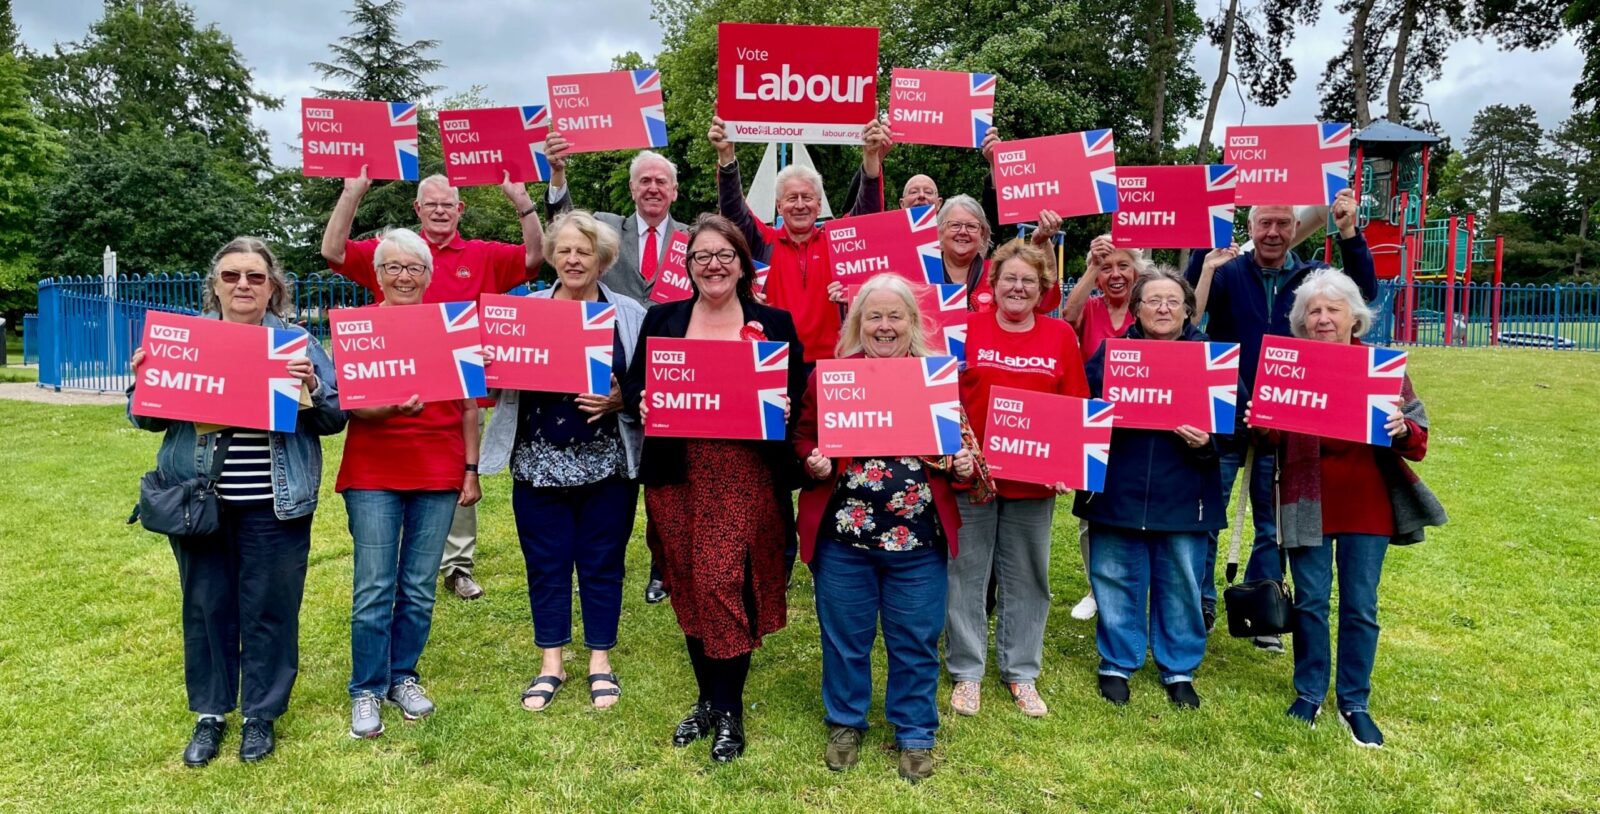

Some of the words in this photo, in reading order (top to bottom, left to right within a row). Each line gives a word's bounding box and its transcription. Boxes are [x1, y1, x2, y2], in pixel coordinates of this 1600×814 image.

[737, 47, 768, 61] Vote
[555, 85, 578, 94] VOTE
[736, 64, 873, 102] Labour
[897, 78, 918, 88] VOTE
[896, 90, 926, 101] VICKI
[555, 97, 589, 108] VICKI
[308, 109, 331, 118] VOTE
[894, 109, 943, 123] SMITH
[307, 121, 342, 132] VICKI
[445, 121, 468, 129] VOTE
[558, 115, 612, 131] SMITH
[735, 125, 758, 135] Vote
[767, 127, 804, 136] Labour
[822, 130, 864, 138] labour.org.
[446, 132, 479, 143] VICKI
[1232, 137, 1256, 146] VOTE
[308, 141, 364, 156] SMITH
[1230, 149, 1266, 160] VICKI
[450, 150, 502, 165] SMITH
[1000, 151, 1024, 161] VOTE
[1000, 163, 1035, 176] VICKI
[1120, 178, 1145, 187] VOTE
[1002, 181, 1059, 200] SMITH
[1119, 191, 1154, 202] VICKI
[1118, 212, 1175, 225] SMITH
[832, 228, 854, 239] VOTE
[833, 240, 865, 253] VICKI
[836, 256, 889, 275] SMITH
[662, 270, 690, 290] SMI
[486, 307, 515, 319] VOTE
[338, 321, 371, 334] VOTE
[485, 322, 525, 336] VICKI
[152, 327, 188, 342] VOTE
[339, 336, 385, 351] VICKI
[150, 343, 198, 361] VICKI
[654, 351, 683, 363] VOTE
[1111, 351, 1139, 361] VOTE
[1266, 347, 1297, 361] VOTE
[995, 351, 1057, 370] Labour
[343, 359, 415, 380] SMITH
[653, 368, 694, 381] VICKI
[1110, 365, 1149, 377] VICKI
[1264, 363, 1305, 379] VICKI
[145, 368, 225, 394] SMITH
[824, 372, 852, 383] VOTE
[824, 388, 865, 400] VICKI
[1109, 387, 1172, 404] SMITH
[1259, 385, 1327, 409] SMITH
[653, 392, 720, 410] SMITH
[994, 398, 1022, 412] VOTE
[825, 411, 892, 428] SMITH
[994, 413, 1030, 429] VICKI
[990, 436, 1050, 458] SMITH
